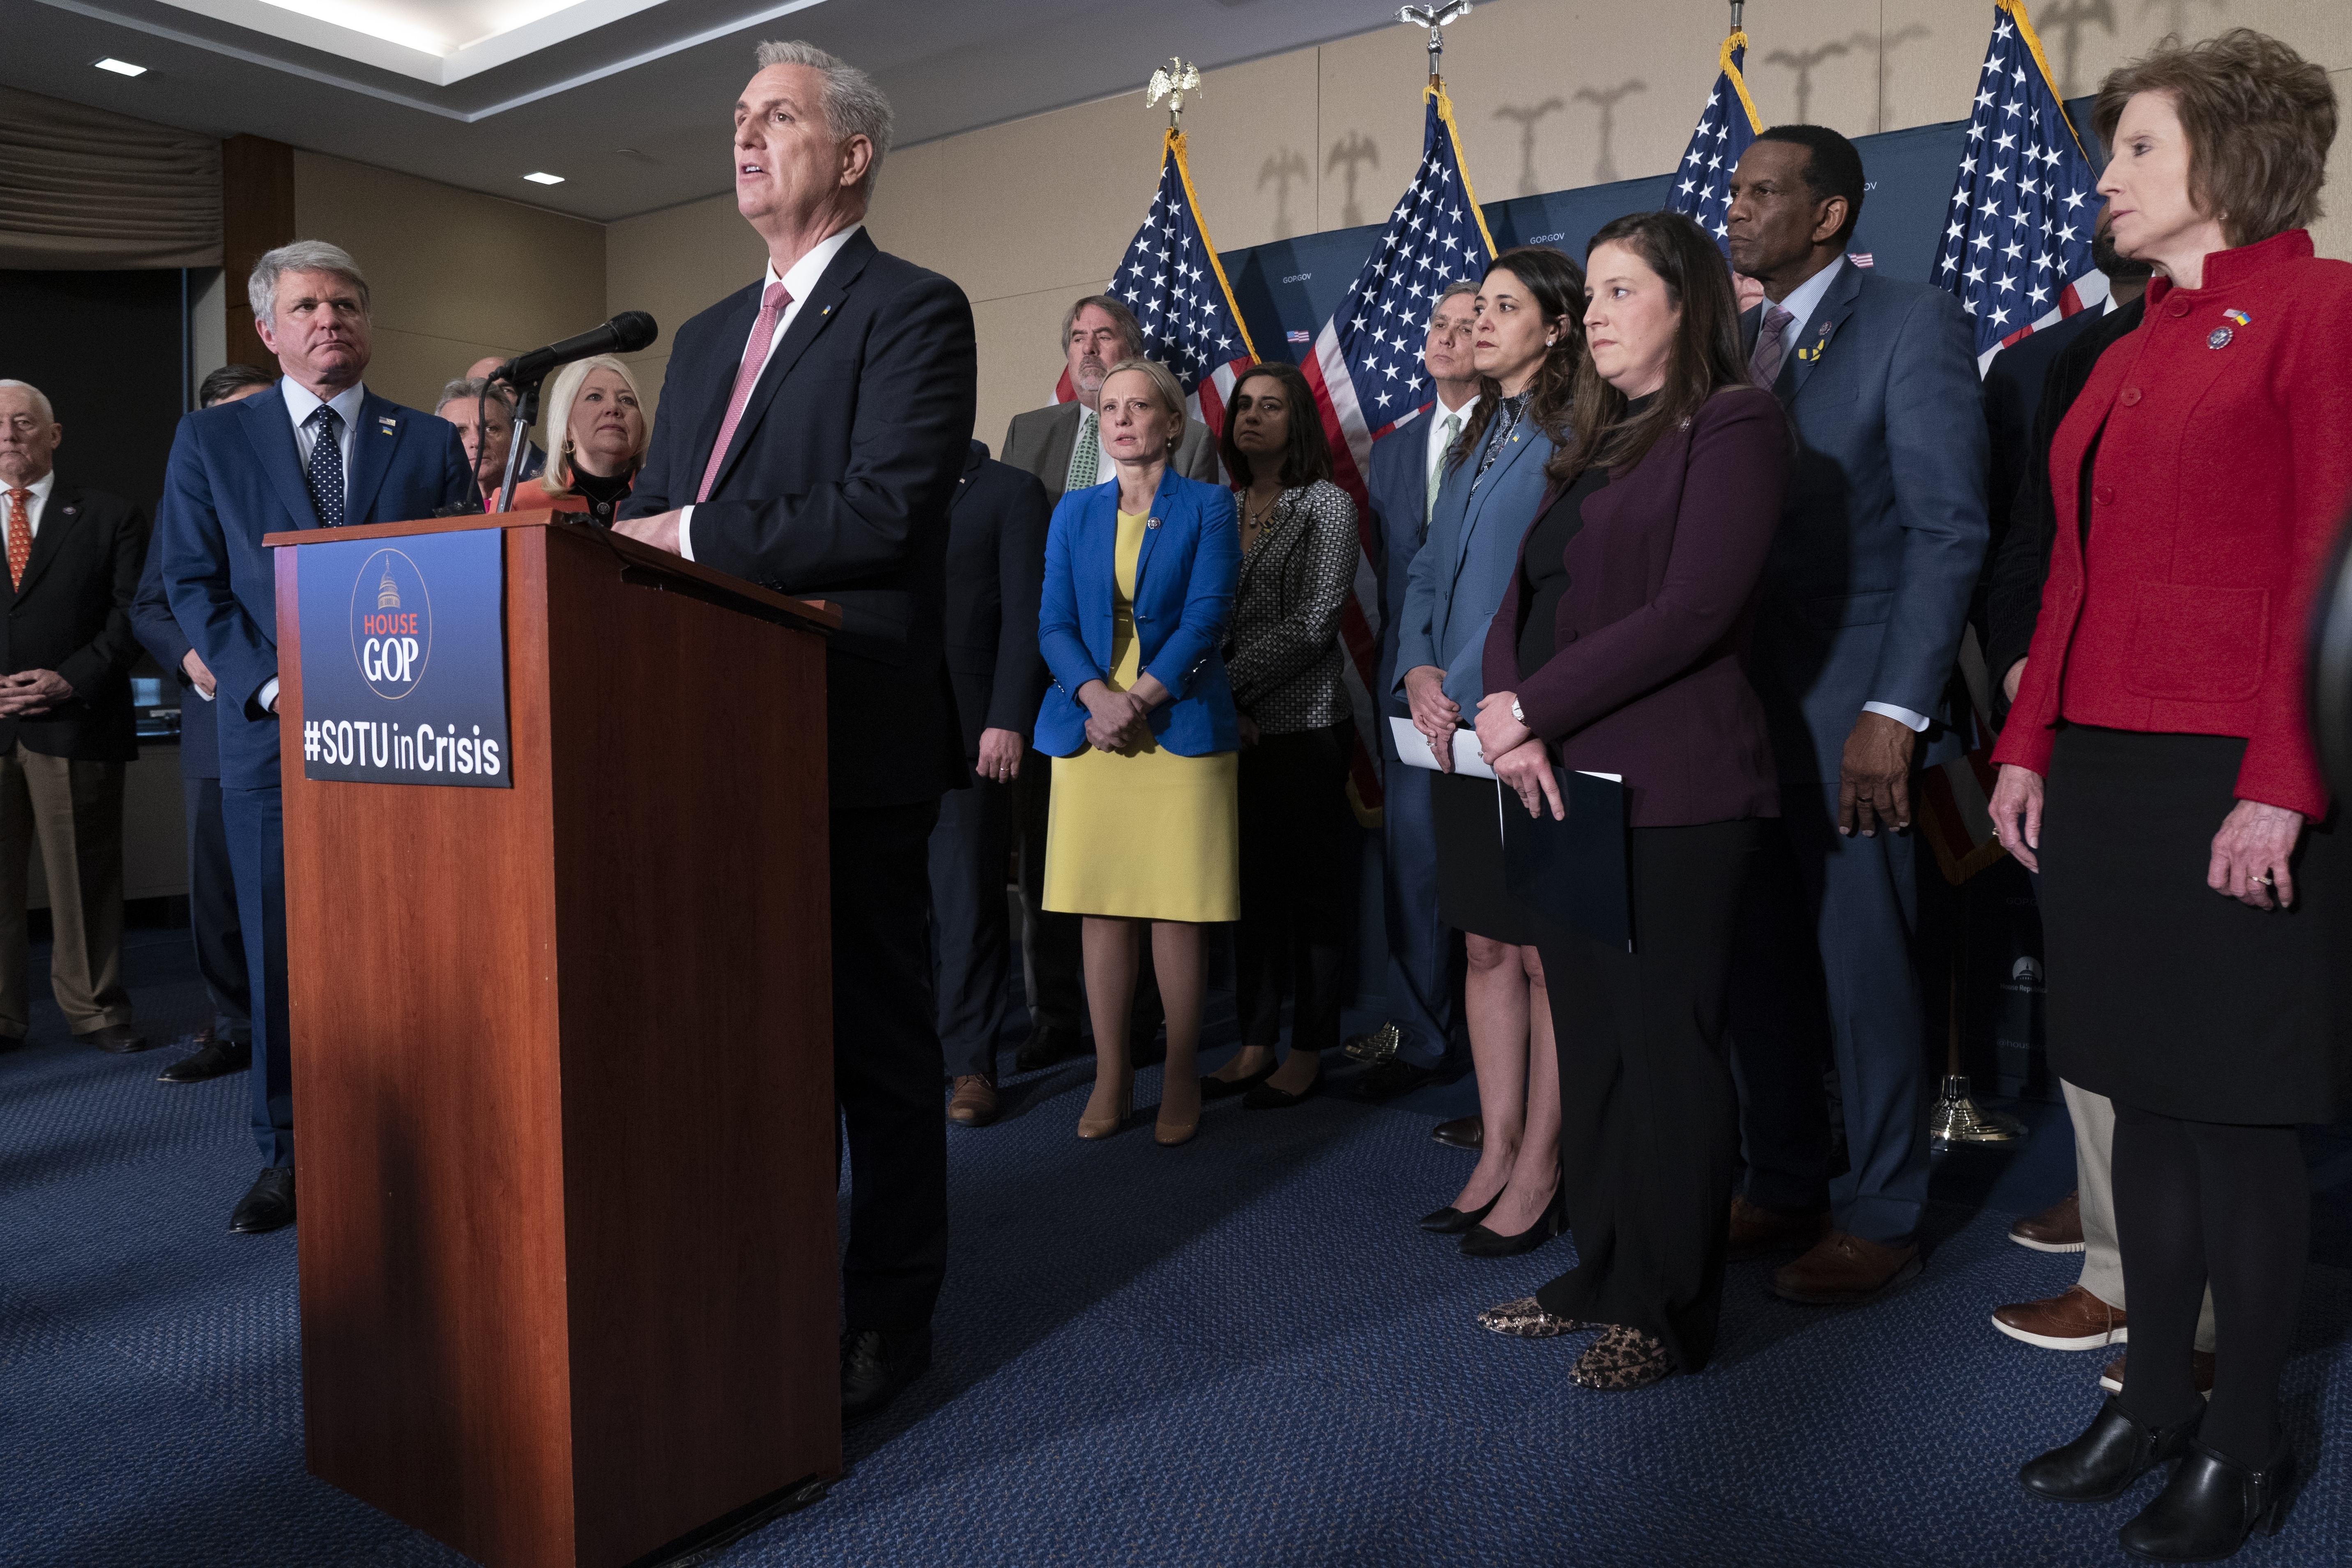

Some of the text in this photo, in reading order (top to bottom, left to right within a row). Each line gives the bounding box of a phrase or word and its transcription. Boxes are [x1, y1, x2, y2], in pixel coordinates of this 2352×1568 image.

[1530, 233, 1565, 244] GOP.GOV
[1283, 273, 1312, 283] GOP.GOV
[364, 613, 419, 635] HOUSE
[363, 638, 419, 682] GOP
[2000, 983, 2018, 991] House
